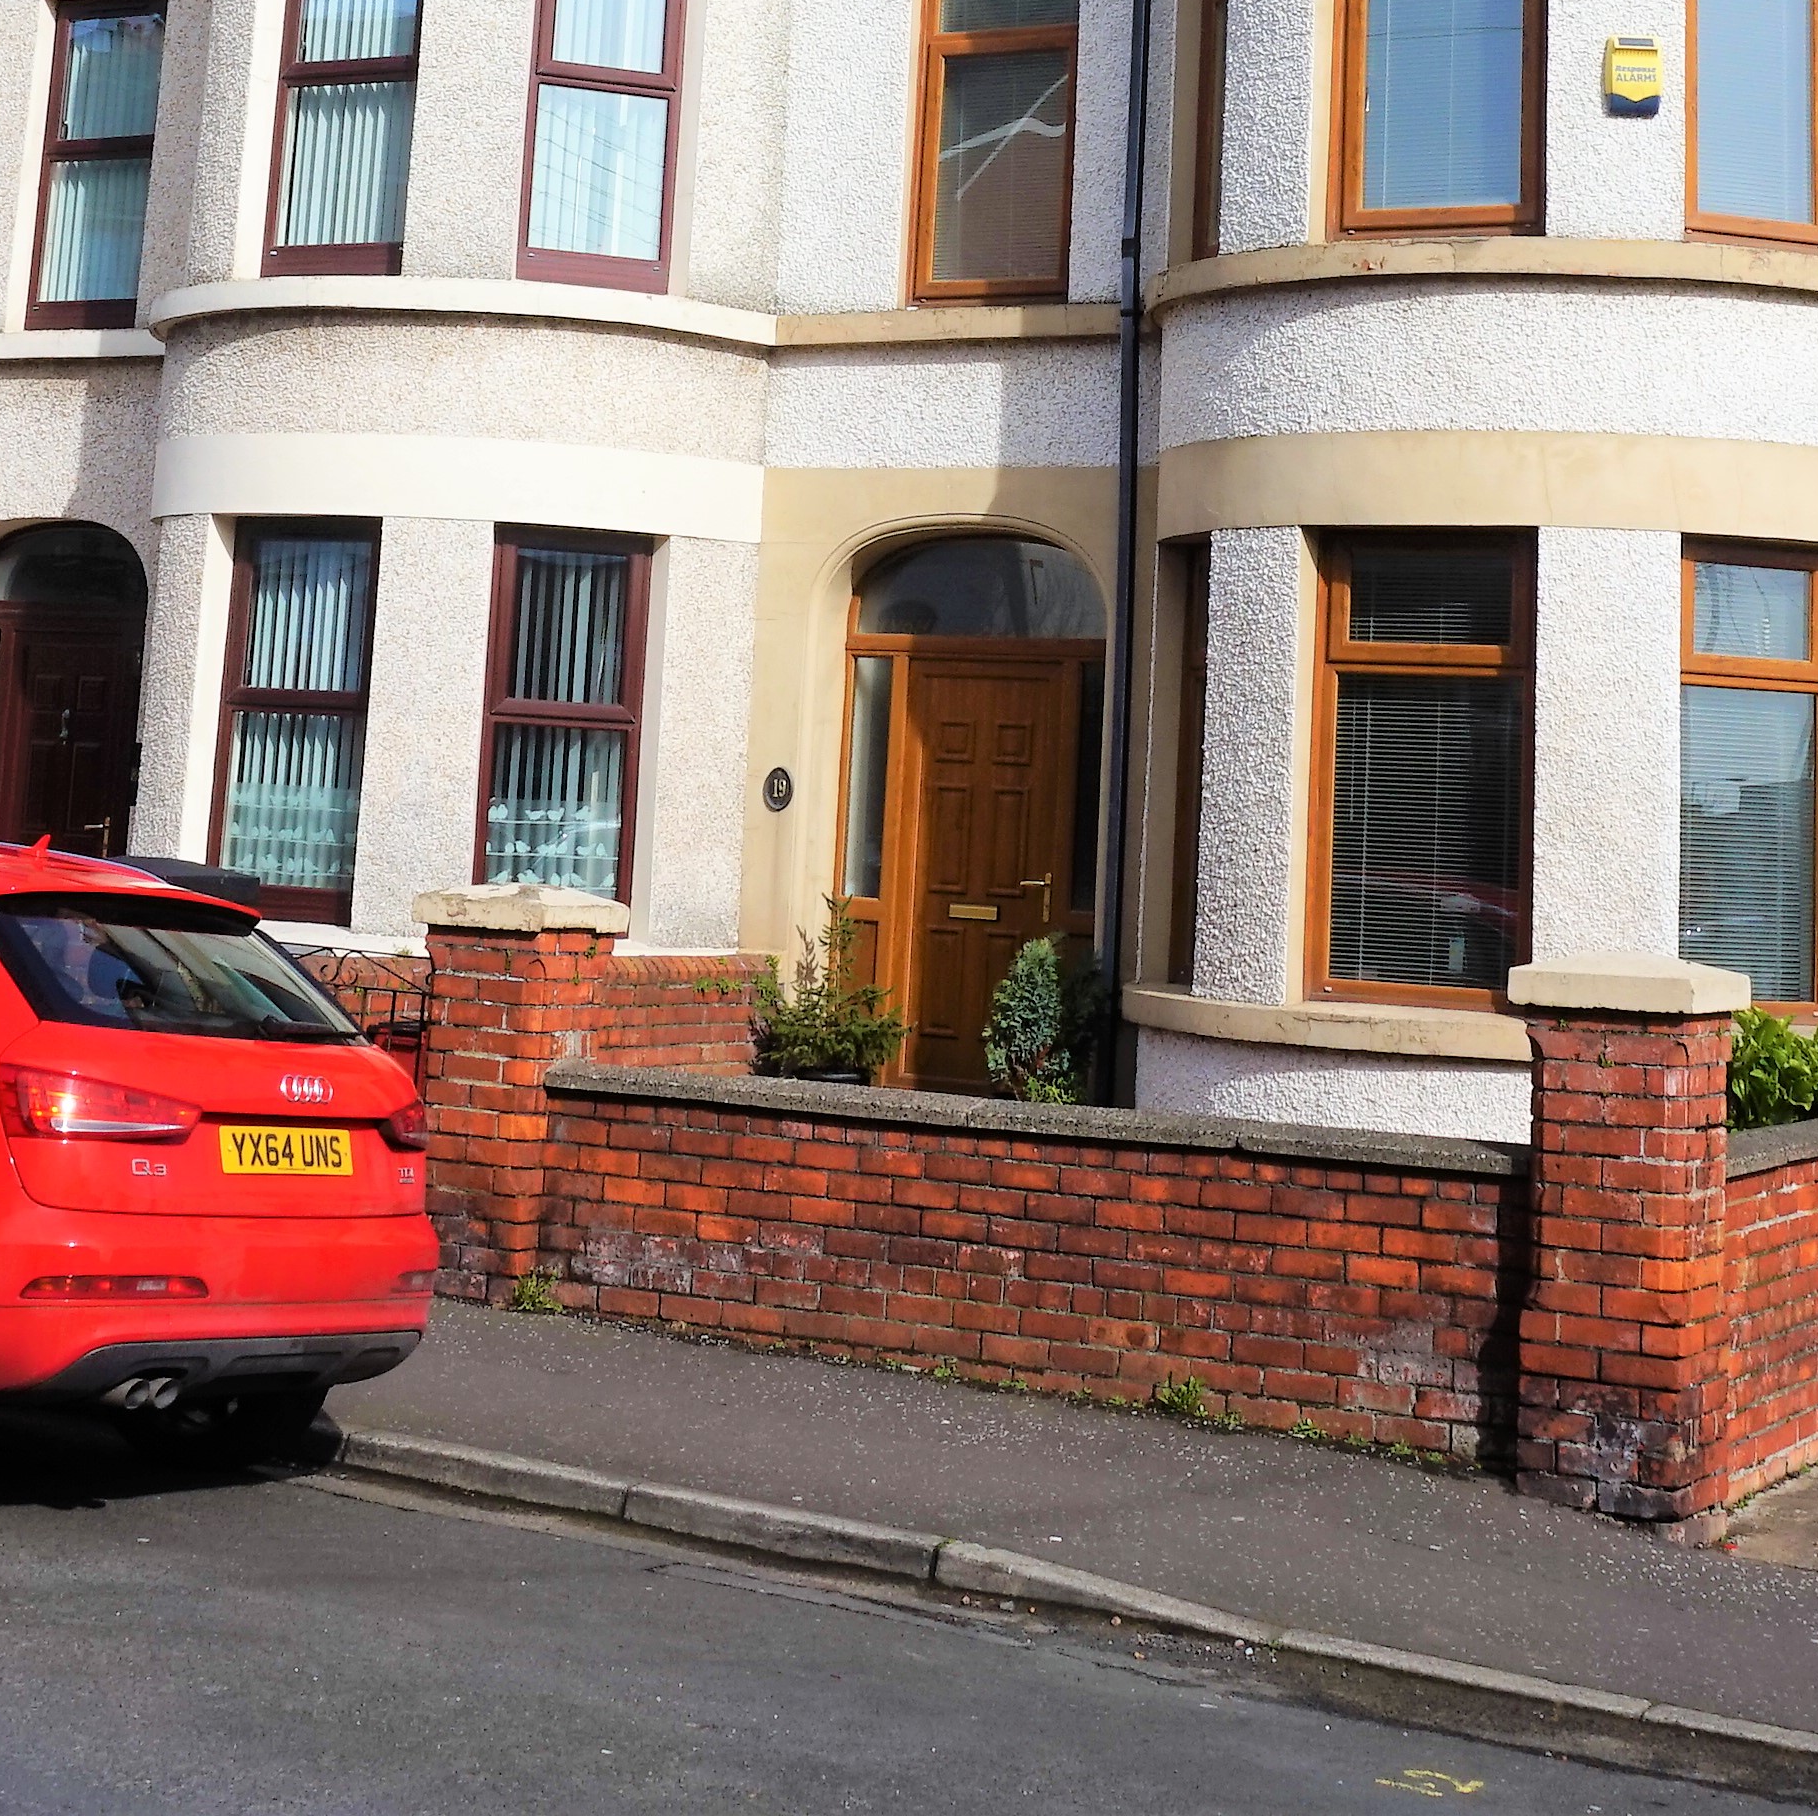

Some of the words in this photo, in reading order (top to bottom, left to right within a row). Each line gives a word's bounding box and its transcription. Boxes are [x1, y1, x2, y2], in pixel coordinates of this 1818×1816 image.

[1616, 73, 1656, 82] ALARMS
[773, 779, 787, 798] 19
[231, 1134, 294, 1169] YX64
[302, 1135, 343, 1169] UNS
[132, 1158, 167, 1176] Q3
